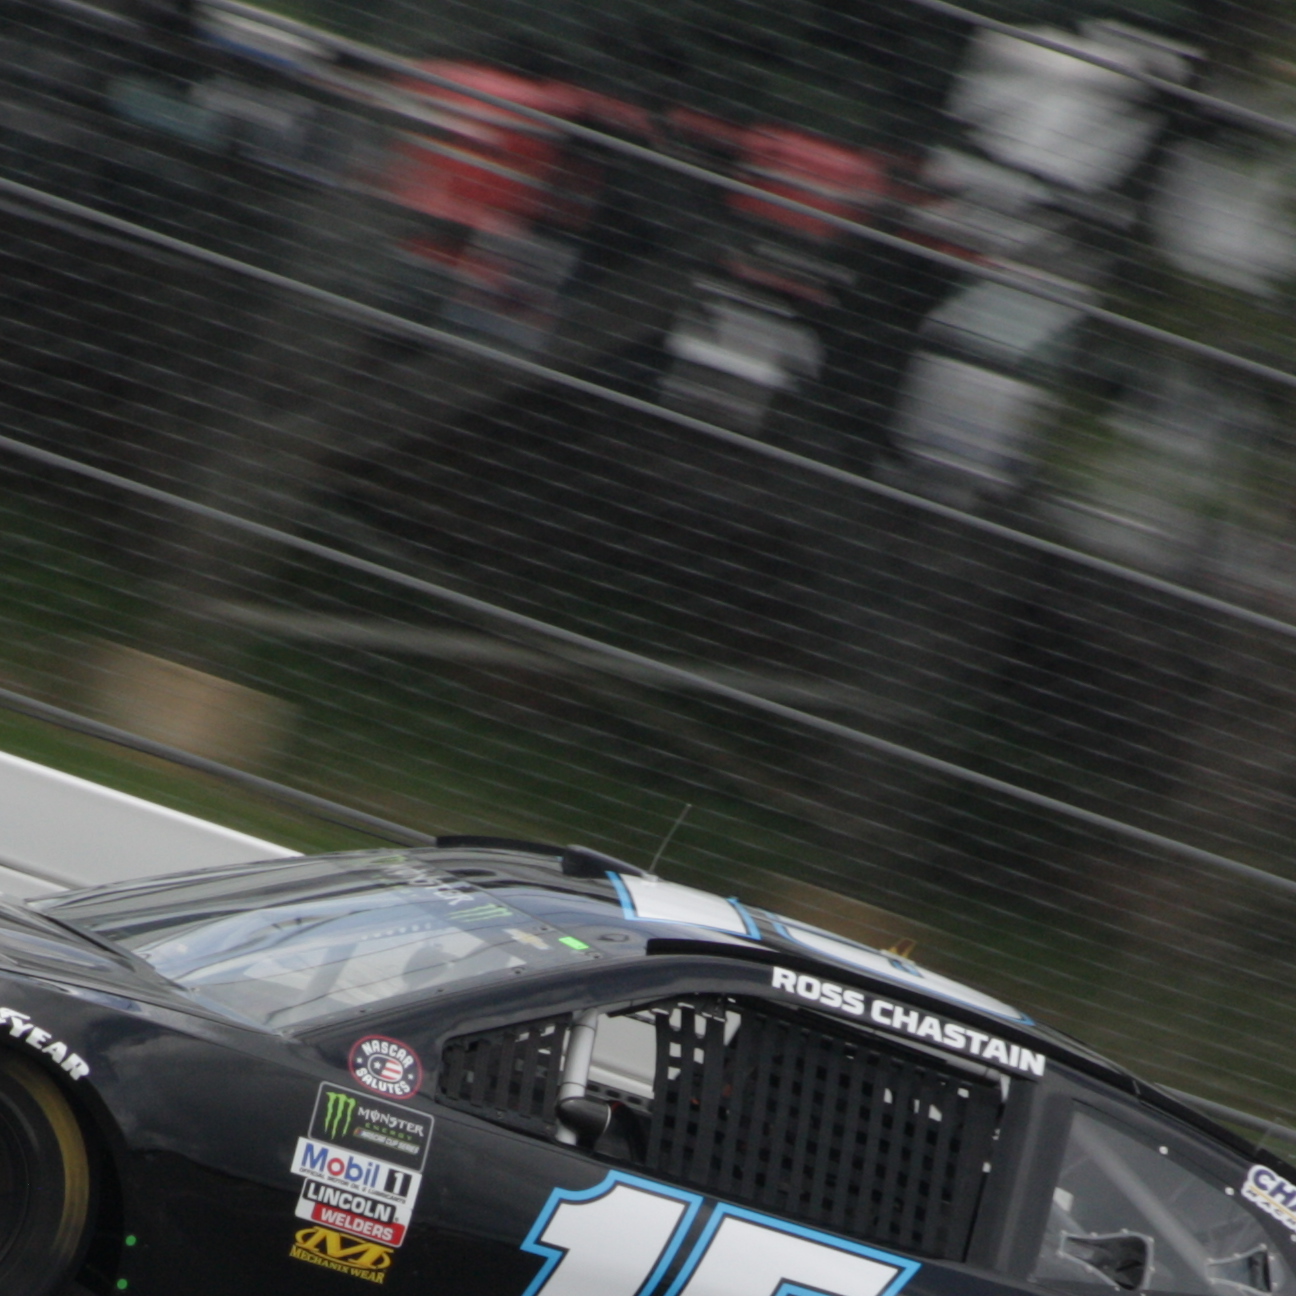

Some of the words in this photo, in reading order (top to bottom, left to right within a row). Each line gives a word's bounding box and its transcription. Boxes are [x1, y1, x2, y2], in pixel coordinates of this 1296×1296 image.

[771, 966, 865, 1017] ROSS
[870, 1000, 1046, 1077] CHASTAIN
[361, 1039, 414, 1069] NASCAR
[355, 1067, 411, 1095] SALUTES
[357, 1106, 424, 1137] MONSTER
[301, 1142, 380, 1188] Mobil
[307, 1182, 392, 1222] LINCOLN
[321, 1207, 394, 1241] WELDERS
[289, 1245, 349, 1274] MECHANIX
[350, 1267, 385, 1284] WEAR
